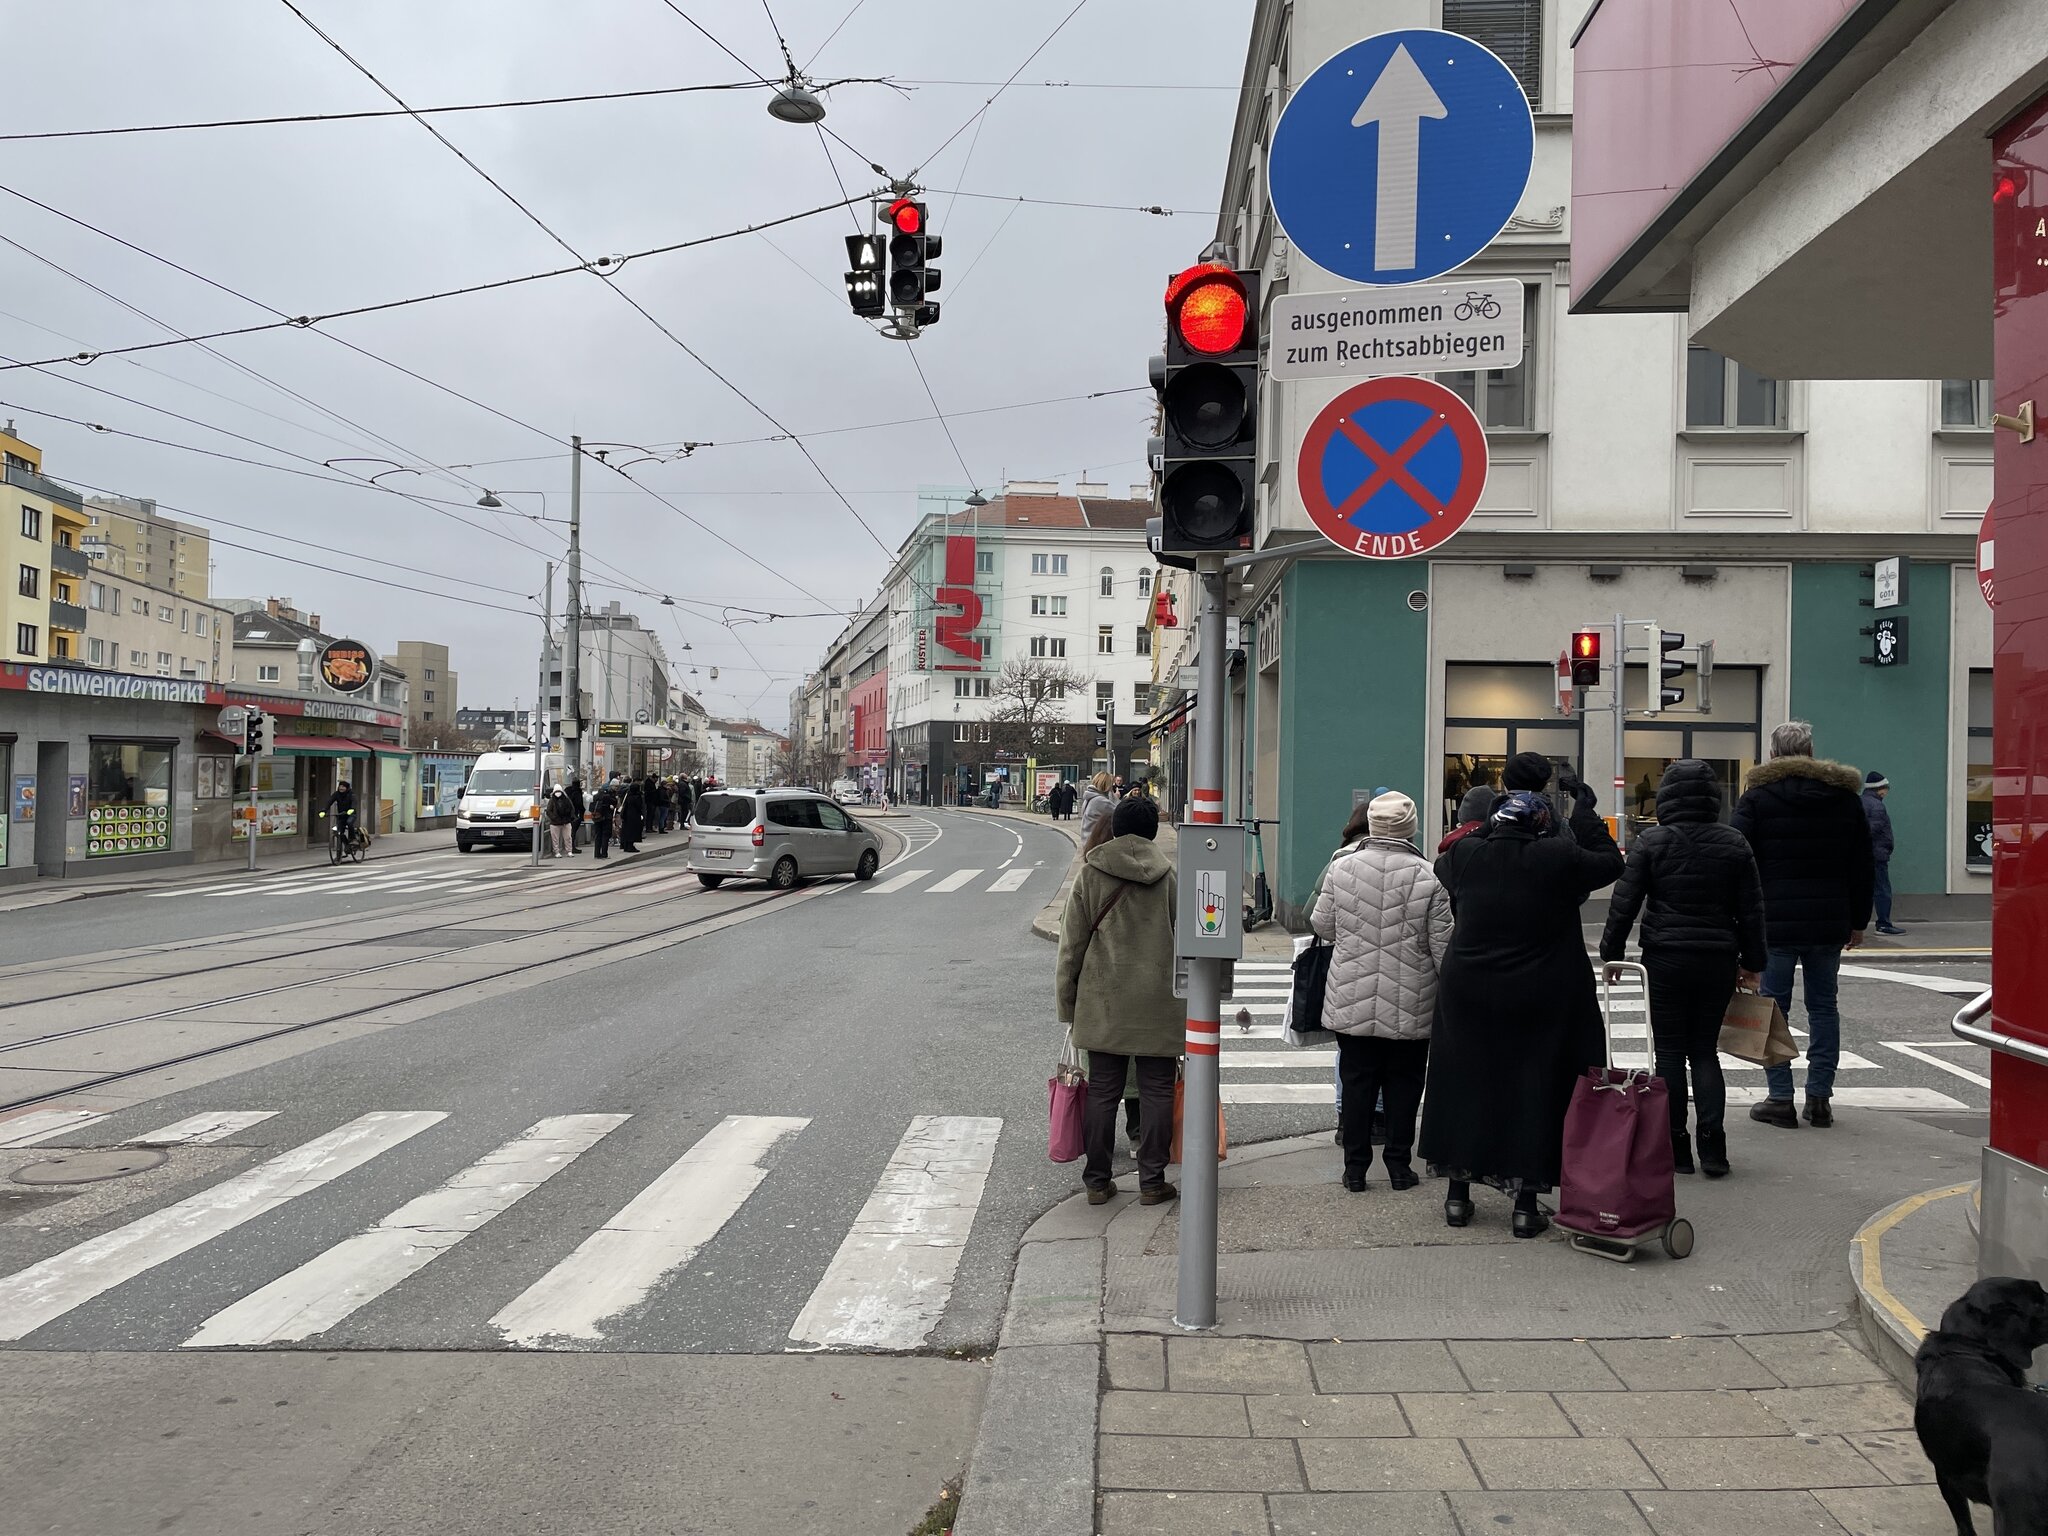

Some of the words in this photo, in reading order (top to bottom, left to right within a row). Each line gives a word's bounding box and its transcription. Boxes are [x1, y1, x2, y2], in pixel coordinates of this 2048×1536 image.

[1291, 305, 1442, 333] ausgenommen
[1286, 345, 1328, 364] zum
[1337, 332, 1505, 361] Rechtsabbiegen
[1354, 530, 1424, 556] ENDE
[1981, 578, 1994, 606] AU
[918, 629, 927, 671] RUSTLER
[27, 668, 206, 704] schwendermarkt
